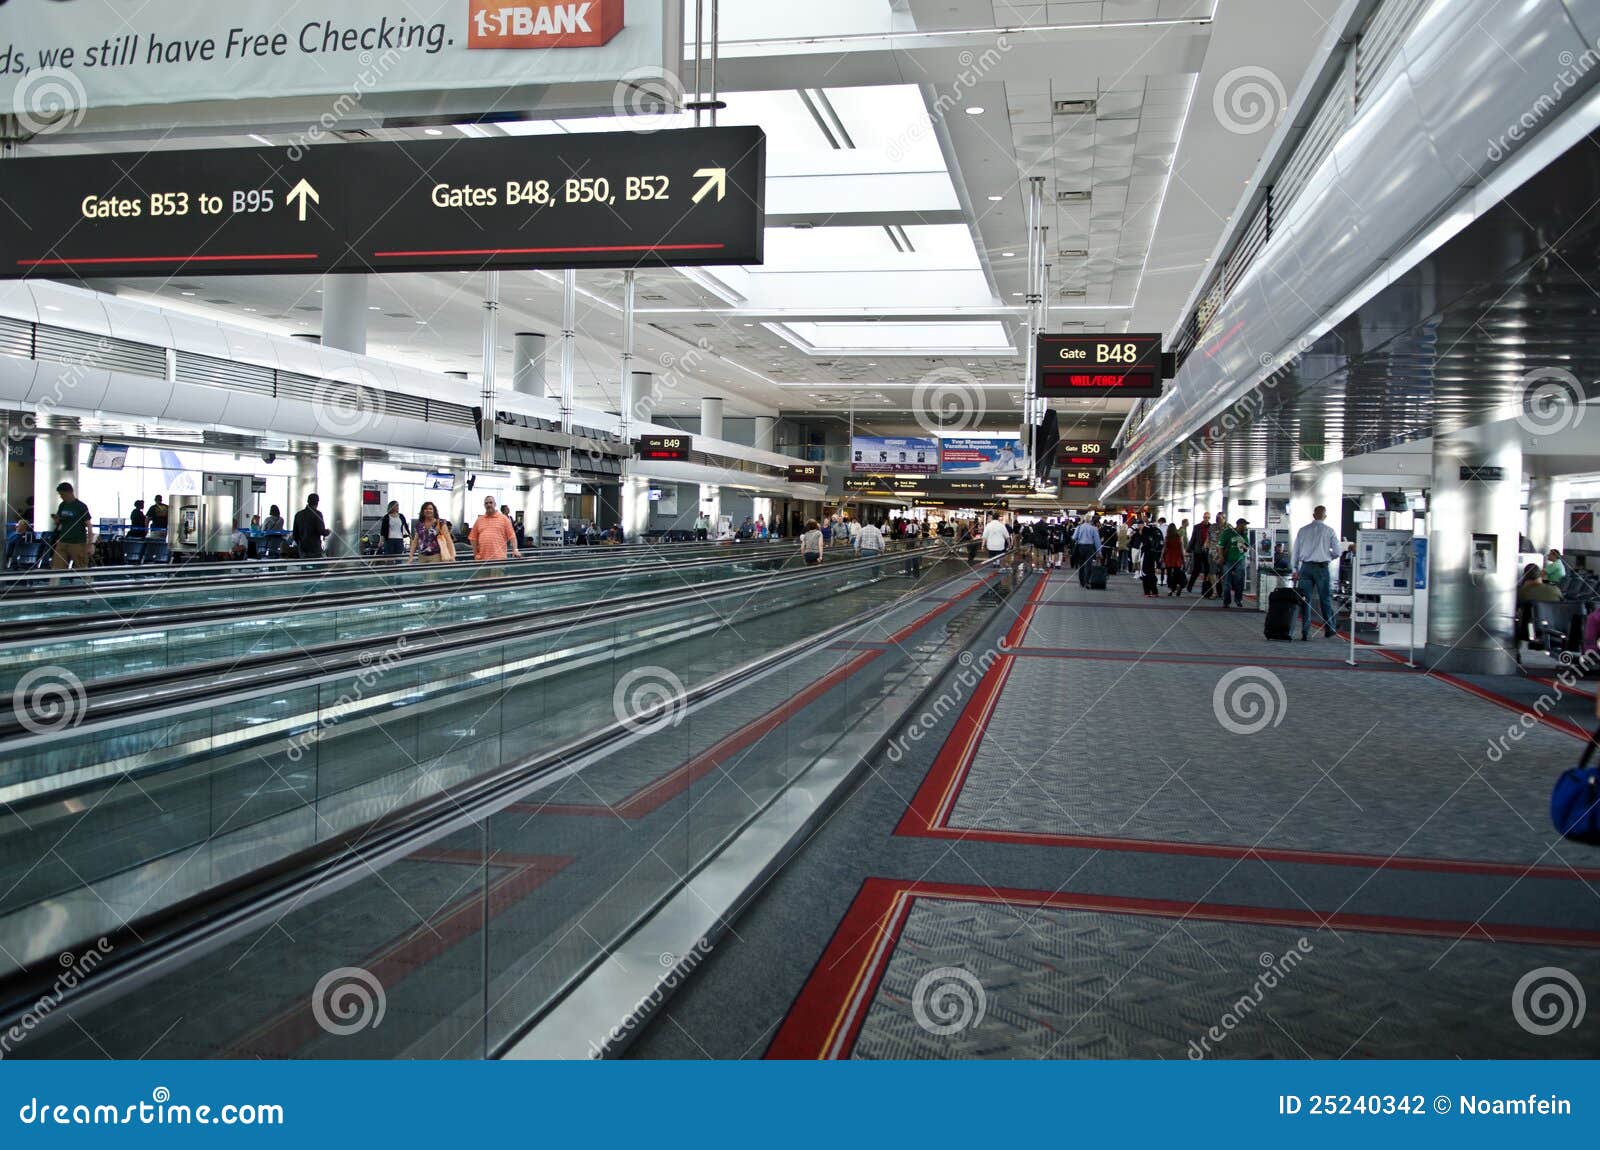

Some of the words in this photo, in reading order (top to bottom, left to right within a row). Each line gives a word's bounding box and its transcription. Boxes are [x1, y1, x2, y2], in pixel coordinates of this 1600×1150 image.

[38, 46, 75, 70] we
[83, 34, 138, 67] still
[146, 33, 215, 64] have
[225, 28, 288, 59] Free
[299, 16, 454, 54] Checking.
[81, 195, 142, 218] Gates
[150, 192, 189, 216] B53
[199, 193, 223, 214] to
[232, 189, 274, 213] B95
[431, 183, 497, 208] Gates
[506, 180, 556, 207] B48,
[565, 178, 616, 205] B50,
[625, 175, 670, 201] B52
[1059, 348, 1086, 359] Gate
[1096, 343, 1137, 363] B48
[664, 439, 680, 448] B49
[1081, 444, 1100, 454] B50
